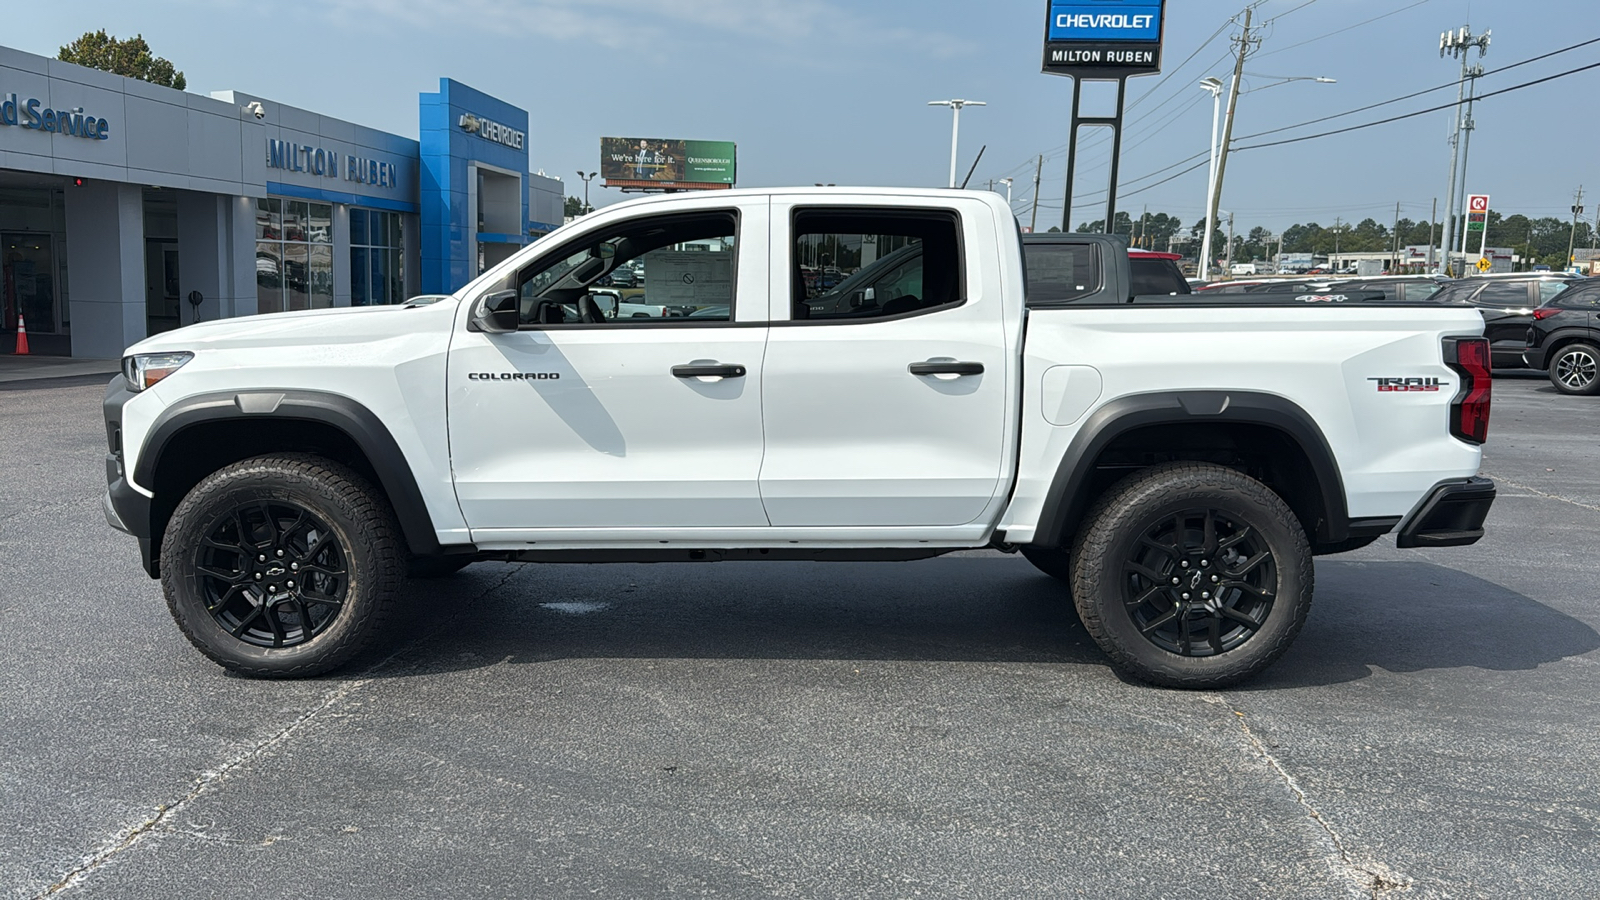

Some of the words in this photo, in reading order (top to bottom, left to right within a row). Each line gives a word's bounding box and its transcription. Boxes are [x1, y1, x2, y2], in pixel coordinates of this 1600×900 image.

[1056, 14, 1153, 28] CHEVROLET
[1052, 50, 1101, 62] MILTON
[1106, 51, 1153, 63] RUBEN
[0, 93, 18, 126] d
[23, 98, 109, 140] Service
[479, 117, 525, 150] CHEVROLET
[267, 138, 338, 178] MILTON
[344, 155, 397, 188] RUBEN
[611, 153, 633, 162] We're
[654, 155, 666, 163] for
[468, 372, 560, 380] COLORADO
[1367, 377, 1449, 386] TRAIL
